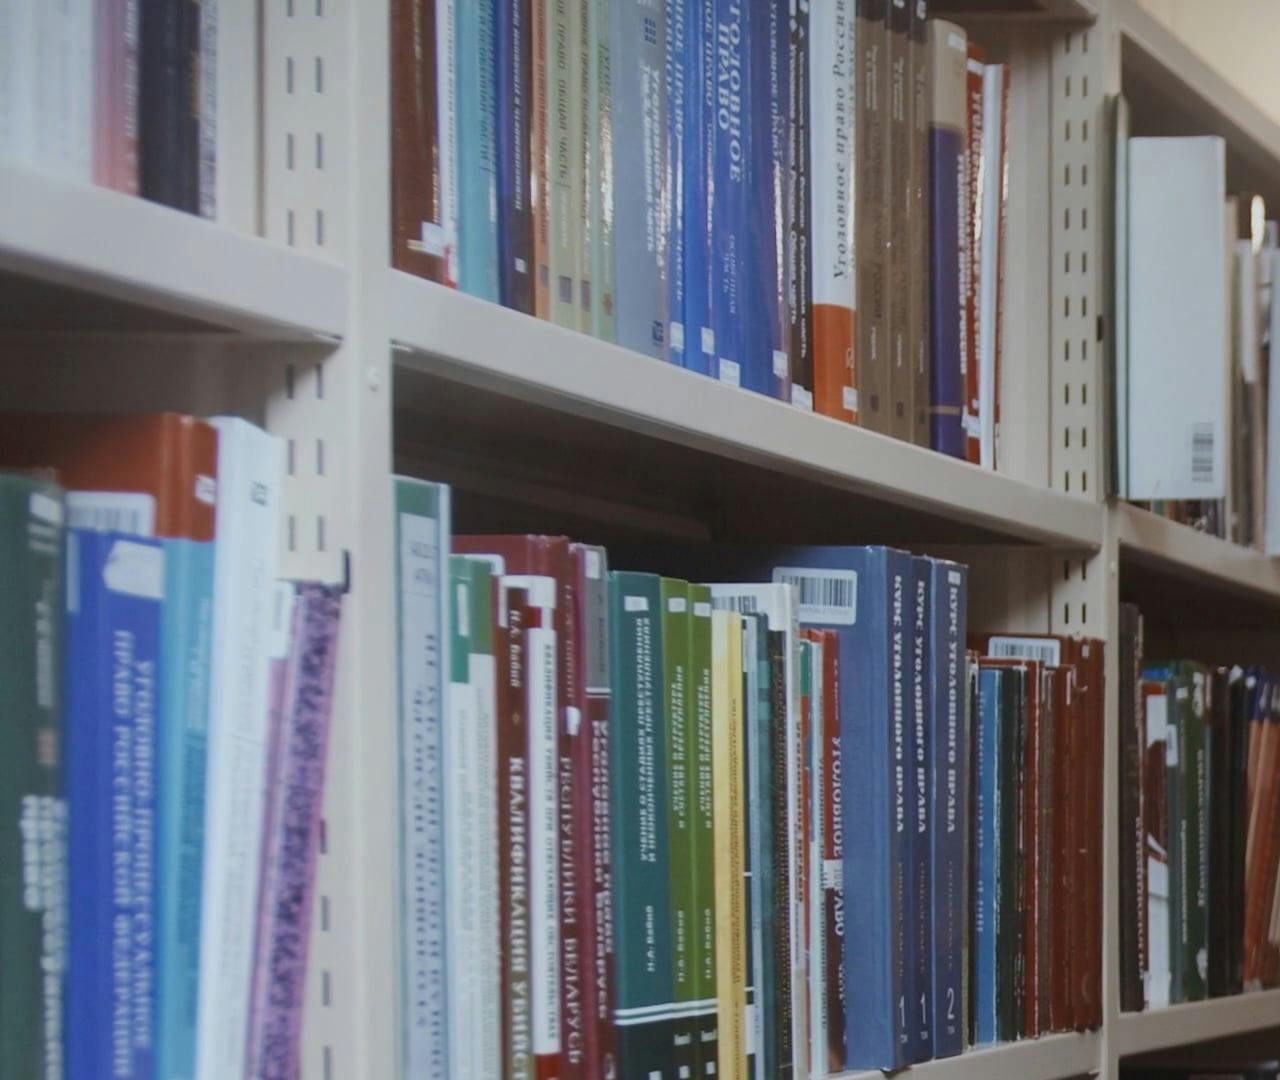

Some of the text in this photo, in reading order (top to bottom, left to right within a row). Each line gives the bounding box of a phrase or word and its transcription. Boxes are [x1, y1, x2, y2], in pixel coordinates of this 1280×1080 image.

[717, 22, 730, 130] ПРАВО
[833, 85, 847, 278] Уголовное право
[113, 629, 135, 1078] ПРАВО РОССИЙСКОЙ ФЕДЕРАЦИИ
[134, 658, 154, 1049] УГОЛОВНО-ПРОЦЕССУАЛЬНОЕ
[509, 756, 525, 972] КВАЛИФИКАЦИЯ
[830, 737, 844, 858] УГОЛОВНОЕ
[561, 755, 581, 1066] РЕСПУБЛИКИ БЕЛАРУСЬ
